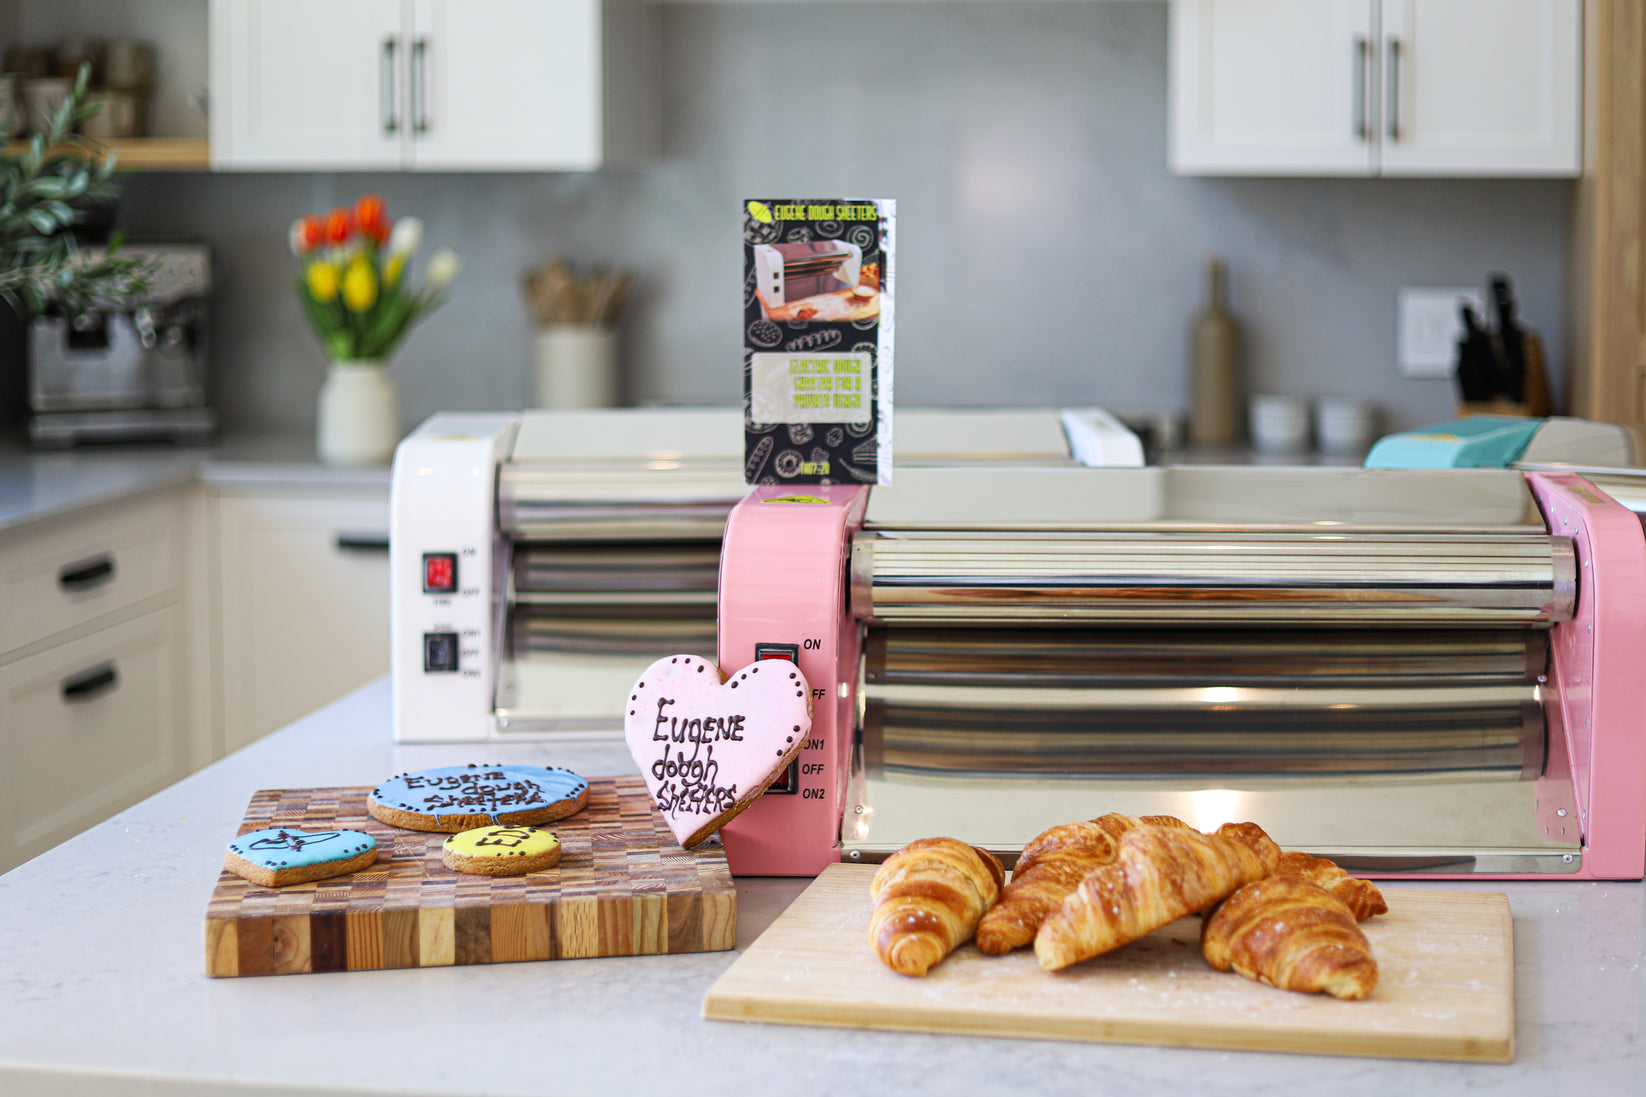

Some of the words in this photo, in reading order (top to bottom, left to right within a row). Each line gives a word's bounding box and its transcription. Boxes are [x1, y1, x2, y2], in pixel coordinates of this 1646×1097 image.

[774, 205, 807, 221] EUGENE
[808, 205, 835, 221] DOUGH
[836, 205, 878, 221] SHEETERS
[789, 359, 830, 374] ELECTRIC
[833, 359, 861, 374] DOUGH
[793, 376, 832, 391] SHEETER
[835, 376, 852, 391] FOR
[793, 394, 830, 408] PRIVATE
[833, 394, 861, 408] USAGE
[803, 638, 822, 650] ON
[812, 688, 826, 700] FF
[802, 763, 825, 775] OFF
[802, 788, 825, 799] ON2
